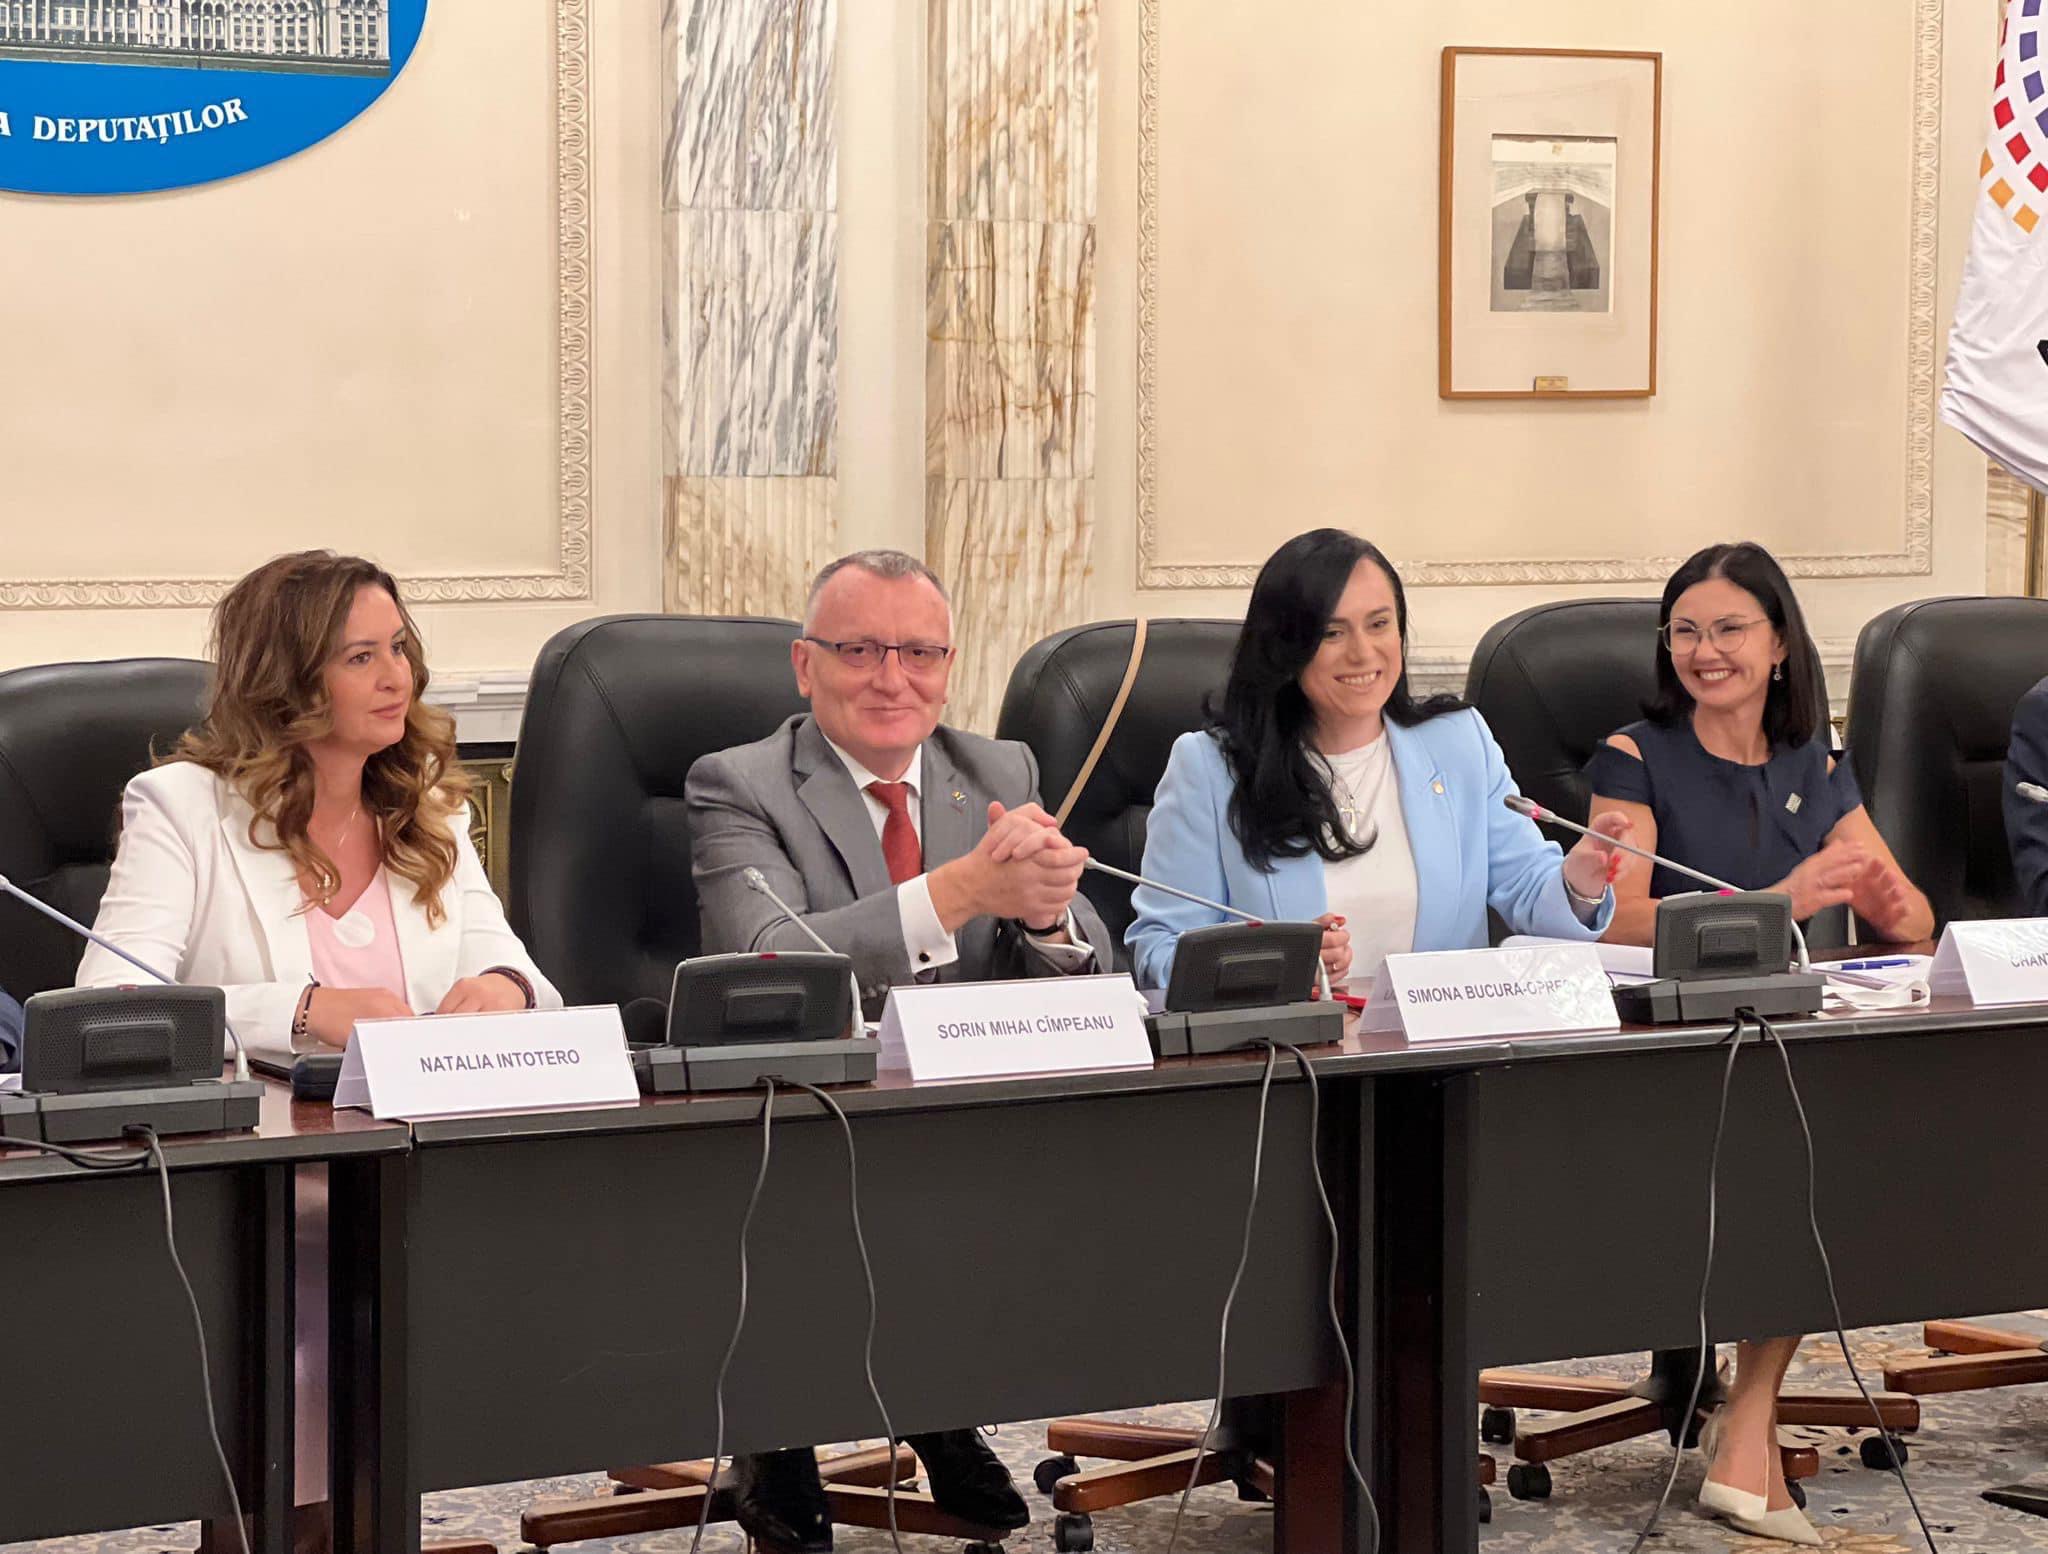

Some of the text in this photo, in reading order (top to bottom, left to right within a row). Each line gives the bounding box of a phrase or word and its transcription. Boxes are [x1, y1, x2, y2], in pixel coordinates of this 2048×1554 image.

[33, 98, 248, 144] DEPUTAȚILOR
[1407, 986, 1461, 1004] SIMONA
[937, 1015, 1114, 1040] SORIN MIHAI CÎMPEANU
[420, 1049, 580, 1074] NATALIA INTOTERO
